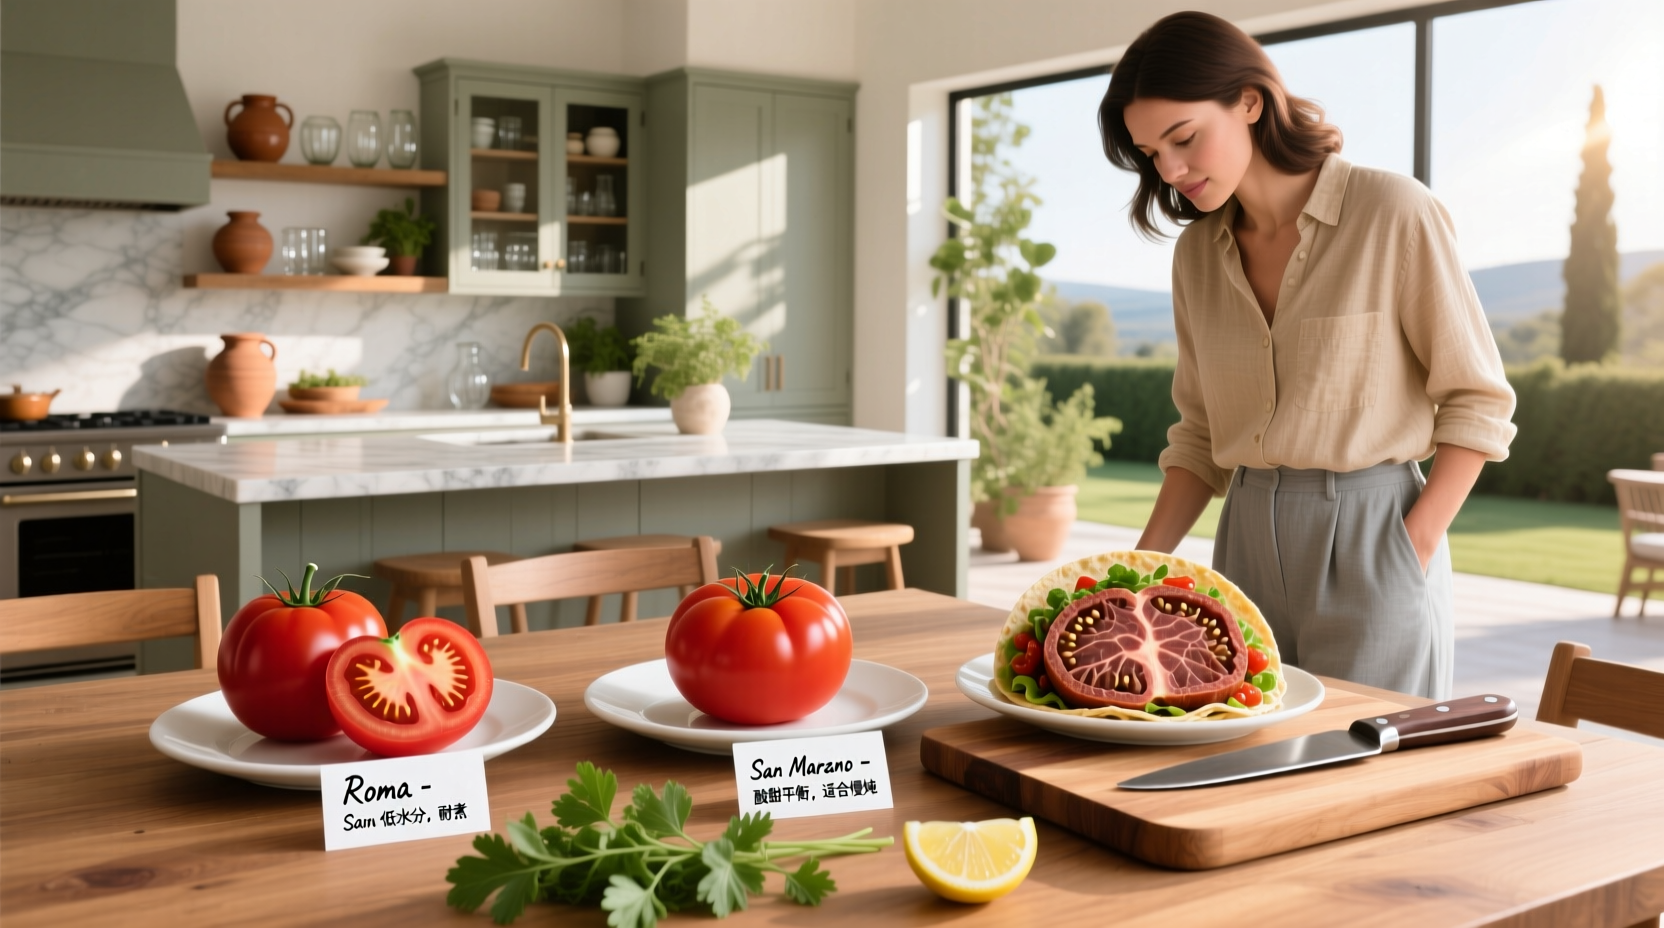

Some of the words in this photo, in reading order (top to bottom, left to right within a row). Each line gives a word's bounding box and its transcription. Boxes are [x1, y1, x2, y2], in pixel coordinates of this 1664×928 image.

[751, 759, 783, 781] San
[789, 755, 854, 778] Marzano
[343, 775, 413, 806] Roma
